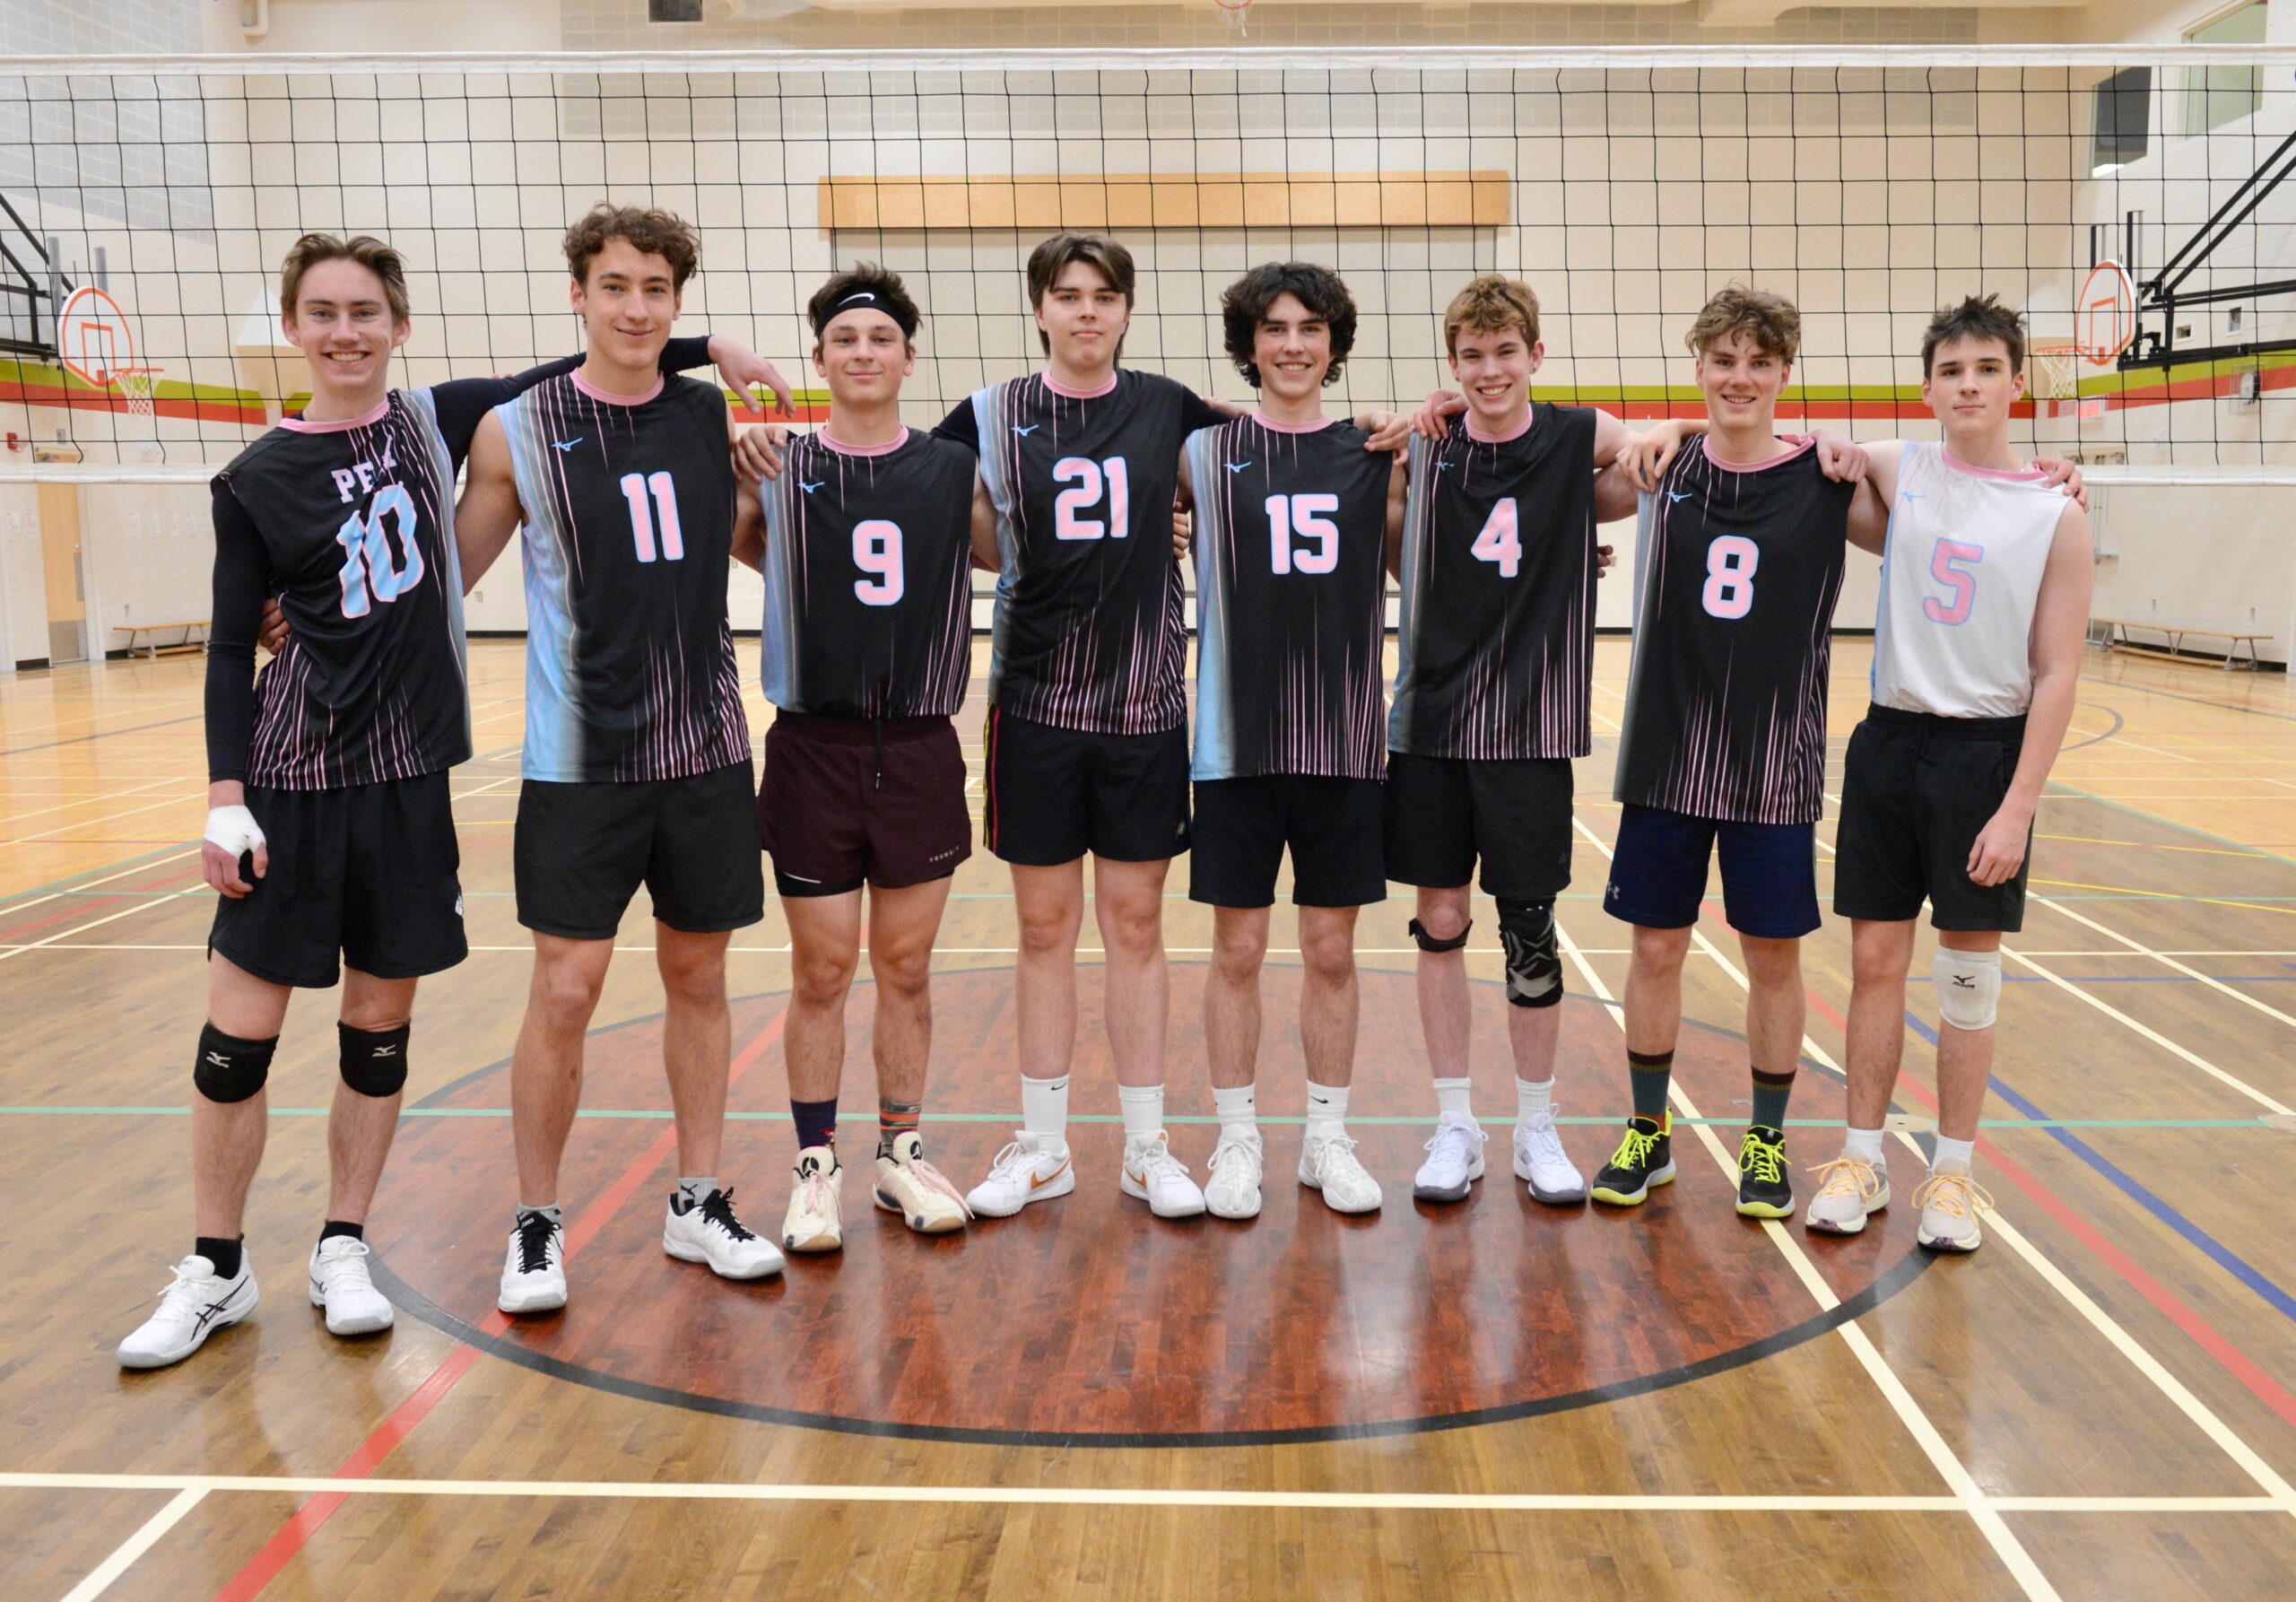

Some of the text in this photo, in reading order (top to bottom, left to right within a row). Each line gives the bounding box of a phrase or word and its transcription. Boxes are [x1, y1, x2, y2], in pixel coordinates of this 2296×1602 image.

[619, 470, 685, 563] 11
[1052, 455, 1129, 540] 21
[1265, 492, 1340, 575] 15
[1470, 497, 1523, 579] 4
[336, 481, 425, 619] 10
[851, 519, 905, 606] 9
[1701, 535, 1760, 620] 8
[1922, 538, 1984, 626] 5
